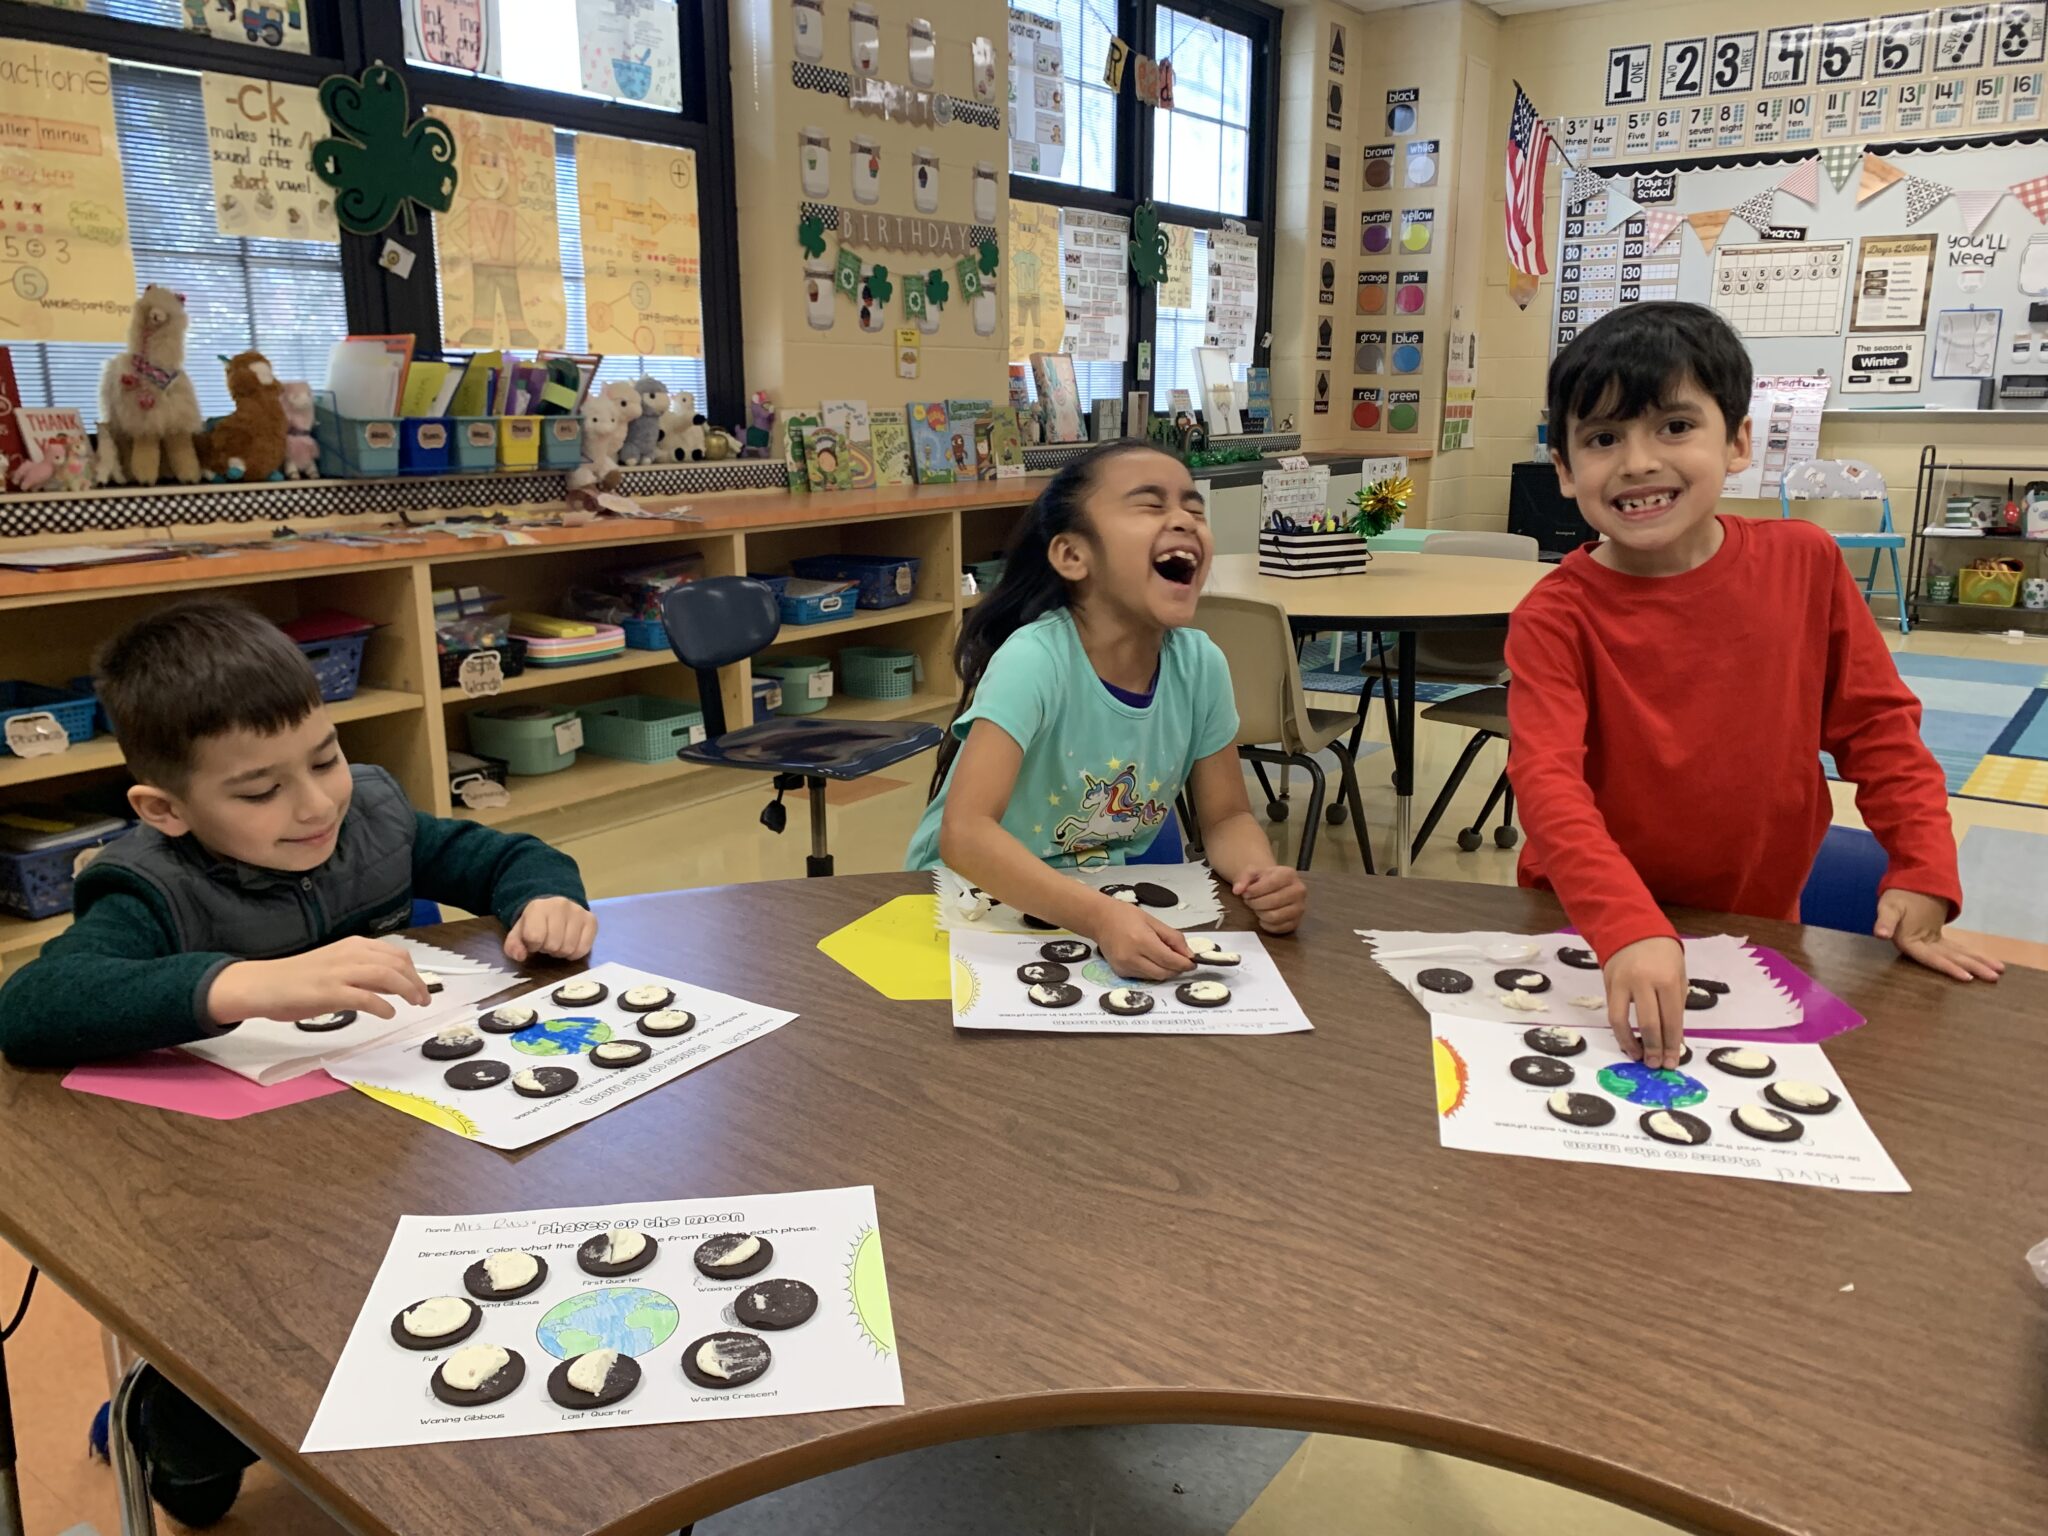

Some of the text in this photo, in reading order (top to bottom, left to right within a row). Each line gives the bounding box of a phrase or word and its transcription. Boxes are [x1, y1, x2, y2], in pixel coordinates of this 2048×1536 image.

[1951, 11, 1983, 63] 7
[2002, 9, 2031, 58] 8
[1883, 21, 1912, 69] 6
[1778, 31, 1807, 80] 4
[1823, 28, 1857, 77] 5
[1715, 42, 1740, 88] 3
[1740, 48, 1753, 74] THREE
[1631, 61, 1645, 83] ONE
[1666, 64, 1678, 84] TWO
[1675, 46, 1699, 91] 2
[1613, 54, 1633, 99] 1
[1768, 70, 1790, 82] FOUR
[1976, 79, 1993, 96] 15
[2013, 76, 2032, 93] 16
[1389, 91, 1416, 102] black
[1899, 87, 1916, 103] 13
[1935, 83, 1953, 100] 14
[1828, 94, 1837, 110] 11
[1861, 90, 1878, 107] 12
[1757, 101, 1769, 117] 9
[1788, 99, 1805, 114] 10
[1657, 112, 1668, 126] 6
[1691, 109, 1701, 124] 7
[1720, 106, 1731, 121] 8
[1566, 120, 1576, 135] 3
[1594, 118, 1604, 133] 4
[1628, 114, 1638, 129] 5
[1755, 121, 1773, 130] nine
[1788, 119, 1804, 128] ten
[210, 122, 257, 143] makes
[268, 128, 293, 147] the
[1658, 130, 1670, 138] six
[1689, 127, 1714, 135] seven
[1720, 124, 1743, 133] eight
[41, 127, 89, 145] minus
[1565, 138, 1588, 146] three
[1627, 132, 1646, 140] five
[1364, 147, 1394, 158] brown
[1410, 143, 1435, 153] white
[213, 147, 251, 165] sound
[259, 151, 293, 170] after
[1637, 179, 1662, 190] Days
[1637, 189, 1671, 199] School
[1362, 212, 1391, 224] purple
[1401, 210, 1433, 223] yellow
[843, 210, 971, 251] BIRTHDAY
[1568, 222, 1582, 235] 20
[1628, 222, 1642, 235] 110
[1766, 228, 1801, 239] March
[5, 235, 71, 264] 5 3
[1565, 247, 1579, 260] 30
[1625, 243, 1642, 256] 120
[1831, 254, 1838, 262] 2
[1949, 251, 1996, 267] Need
[1359, 273, 1388, 283] orange
[1402, 273, 1420, 283] pink
[1564, 268, 1579, 280] 40
[1623, 266, 1640, 279] 130
[1724, 271, 1730, 279] 3
[1776, 269, 1782, 277] 6
[1794, 269, 1800, 277] 7
[22, 273, 38, 297] 5
[1722, 284, 1731, 292] 10
[1562, 290, 1577, 302] 50
[1621, 287, 1639, 300] 140
[1561, 309, 1576, 321] 60
[1360, 333, 1382, 343] gray
[1395, 333, 1419, 344] blue
[1560, 330, 1574, 342] 70
[1860, 356, 1900, 368] Winter
[1359, 391, 1377, 400] red
[1389, 392, 1418, 402] green
[26, 413, 80, 432] THANK
[538, 1220, 611, 1236] Phases
[644, 1216, 680, 1229] the
[685, 1211, 745, 1225] moon
[418, 1225, 819, 1258] Directions: Color what the from each phase.
[582, 1277, 643, 1287] First Quarter
[690, 1390, 778, 1403] Waning Crescent
[420, 1412, 505, 1426] Waning Gibbous
[561, 1408, 633, 1421] Last Quarter
